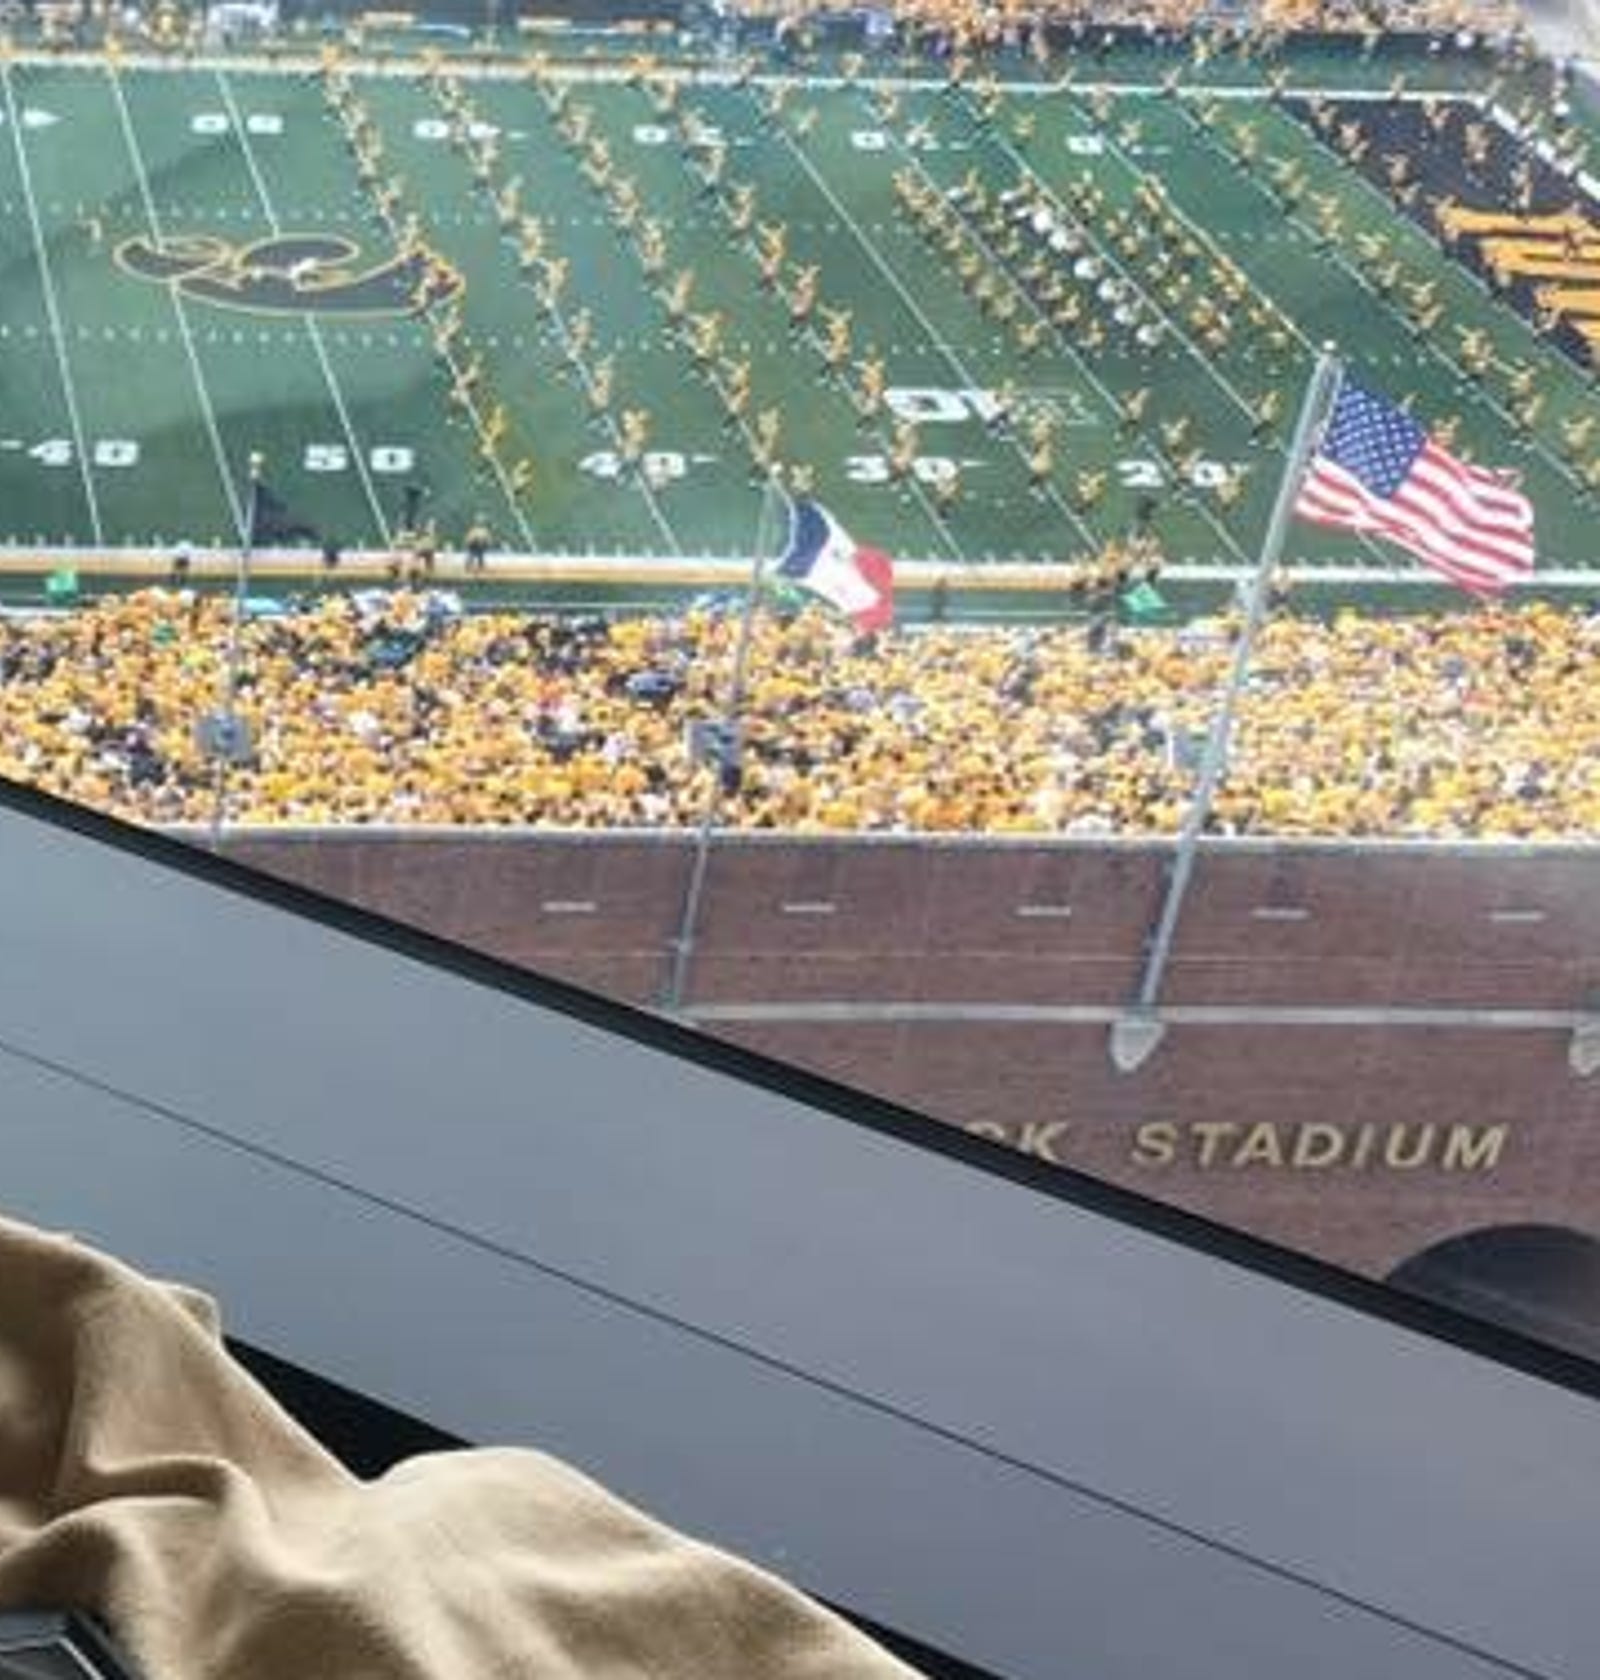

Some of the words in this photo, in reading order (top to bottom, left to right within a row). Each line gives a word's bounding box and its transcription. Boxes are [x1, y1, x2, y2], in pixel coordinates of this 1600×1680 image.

[28, 439, 140, 467] 40
[304, 444, 415, 471] 50
[1131, 1122, 1510, 1171] STADIUM
